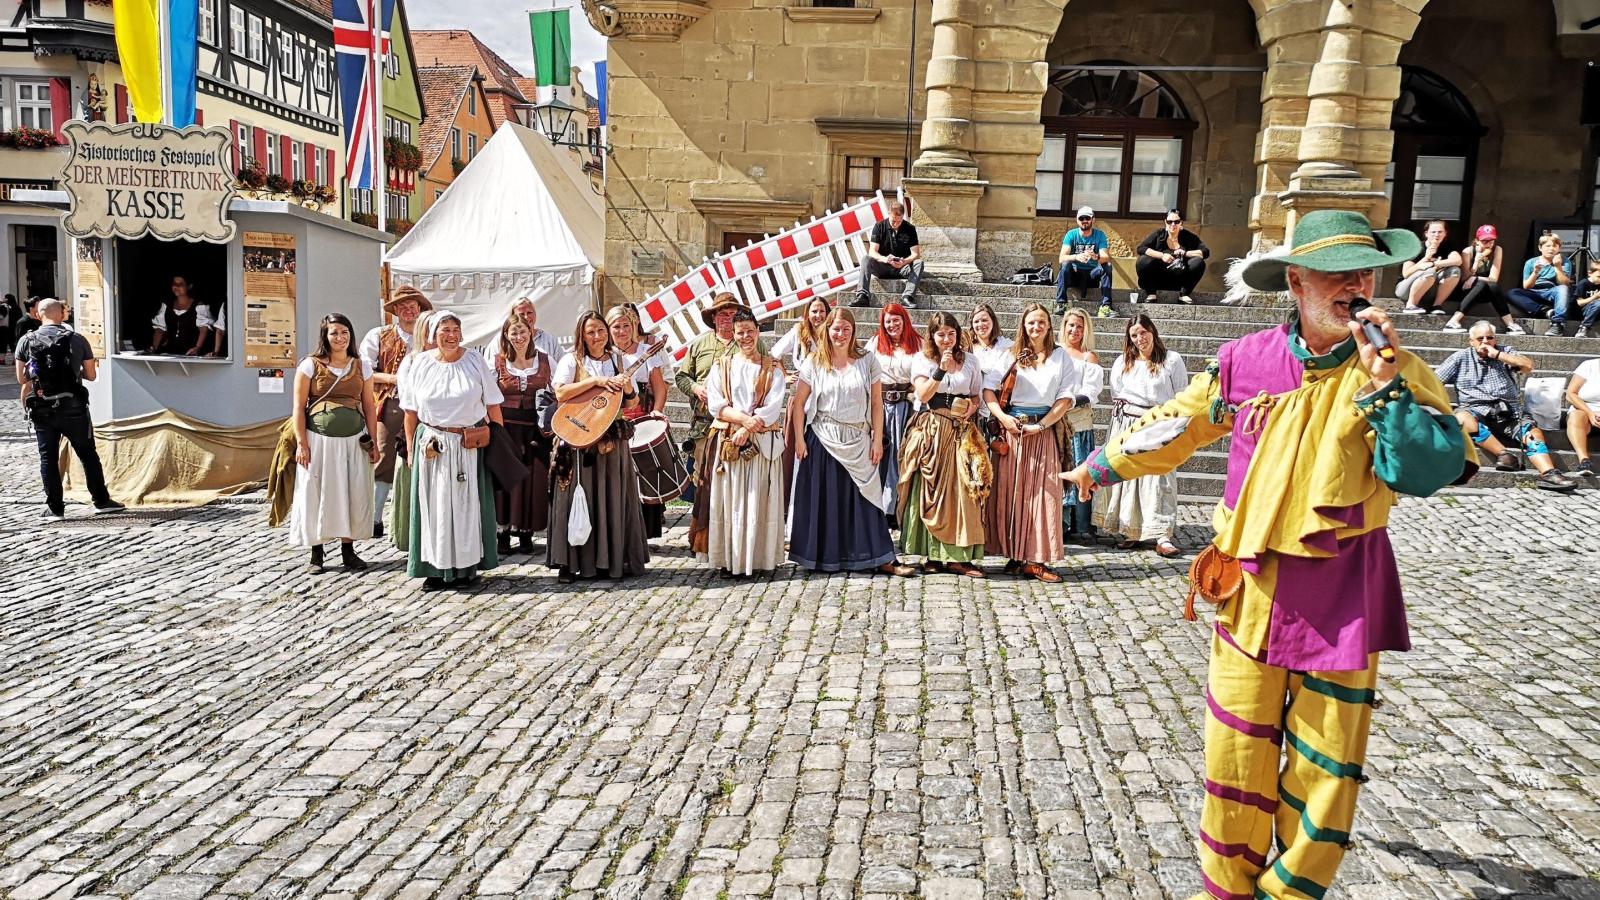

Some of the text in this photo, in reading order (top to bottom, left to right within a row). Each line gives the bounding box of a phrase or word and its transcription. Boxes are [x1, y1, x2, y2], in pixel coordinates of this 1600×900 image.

[78, 142, 215, 168] Historisches Festspiel
[74, 165, 223, 191] DER MEISTERTRUNK
[106, 189, 185, 220] KASSE
